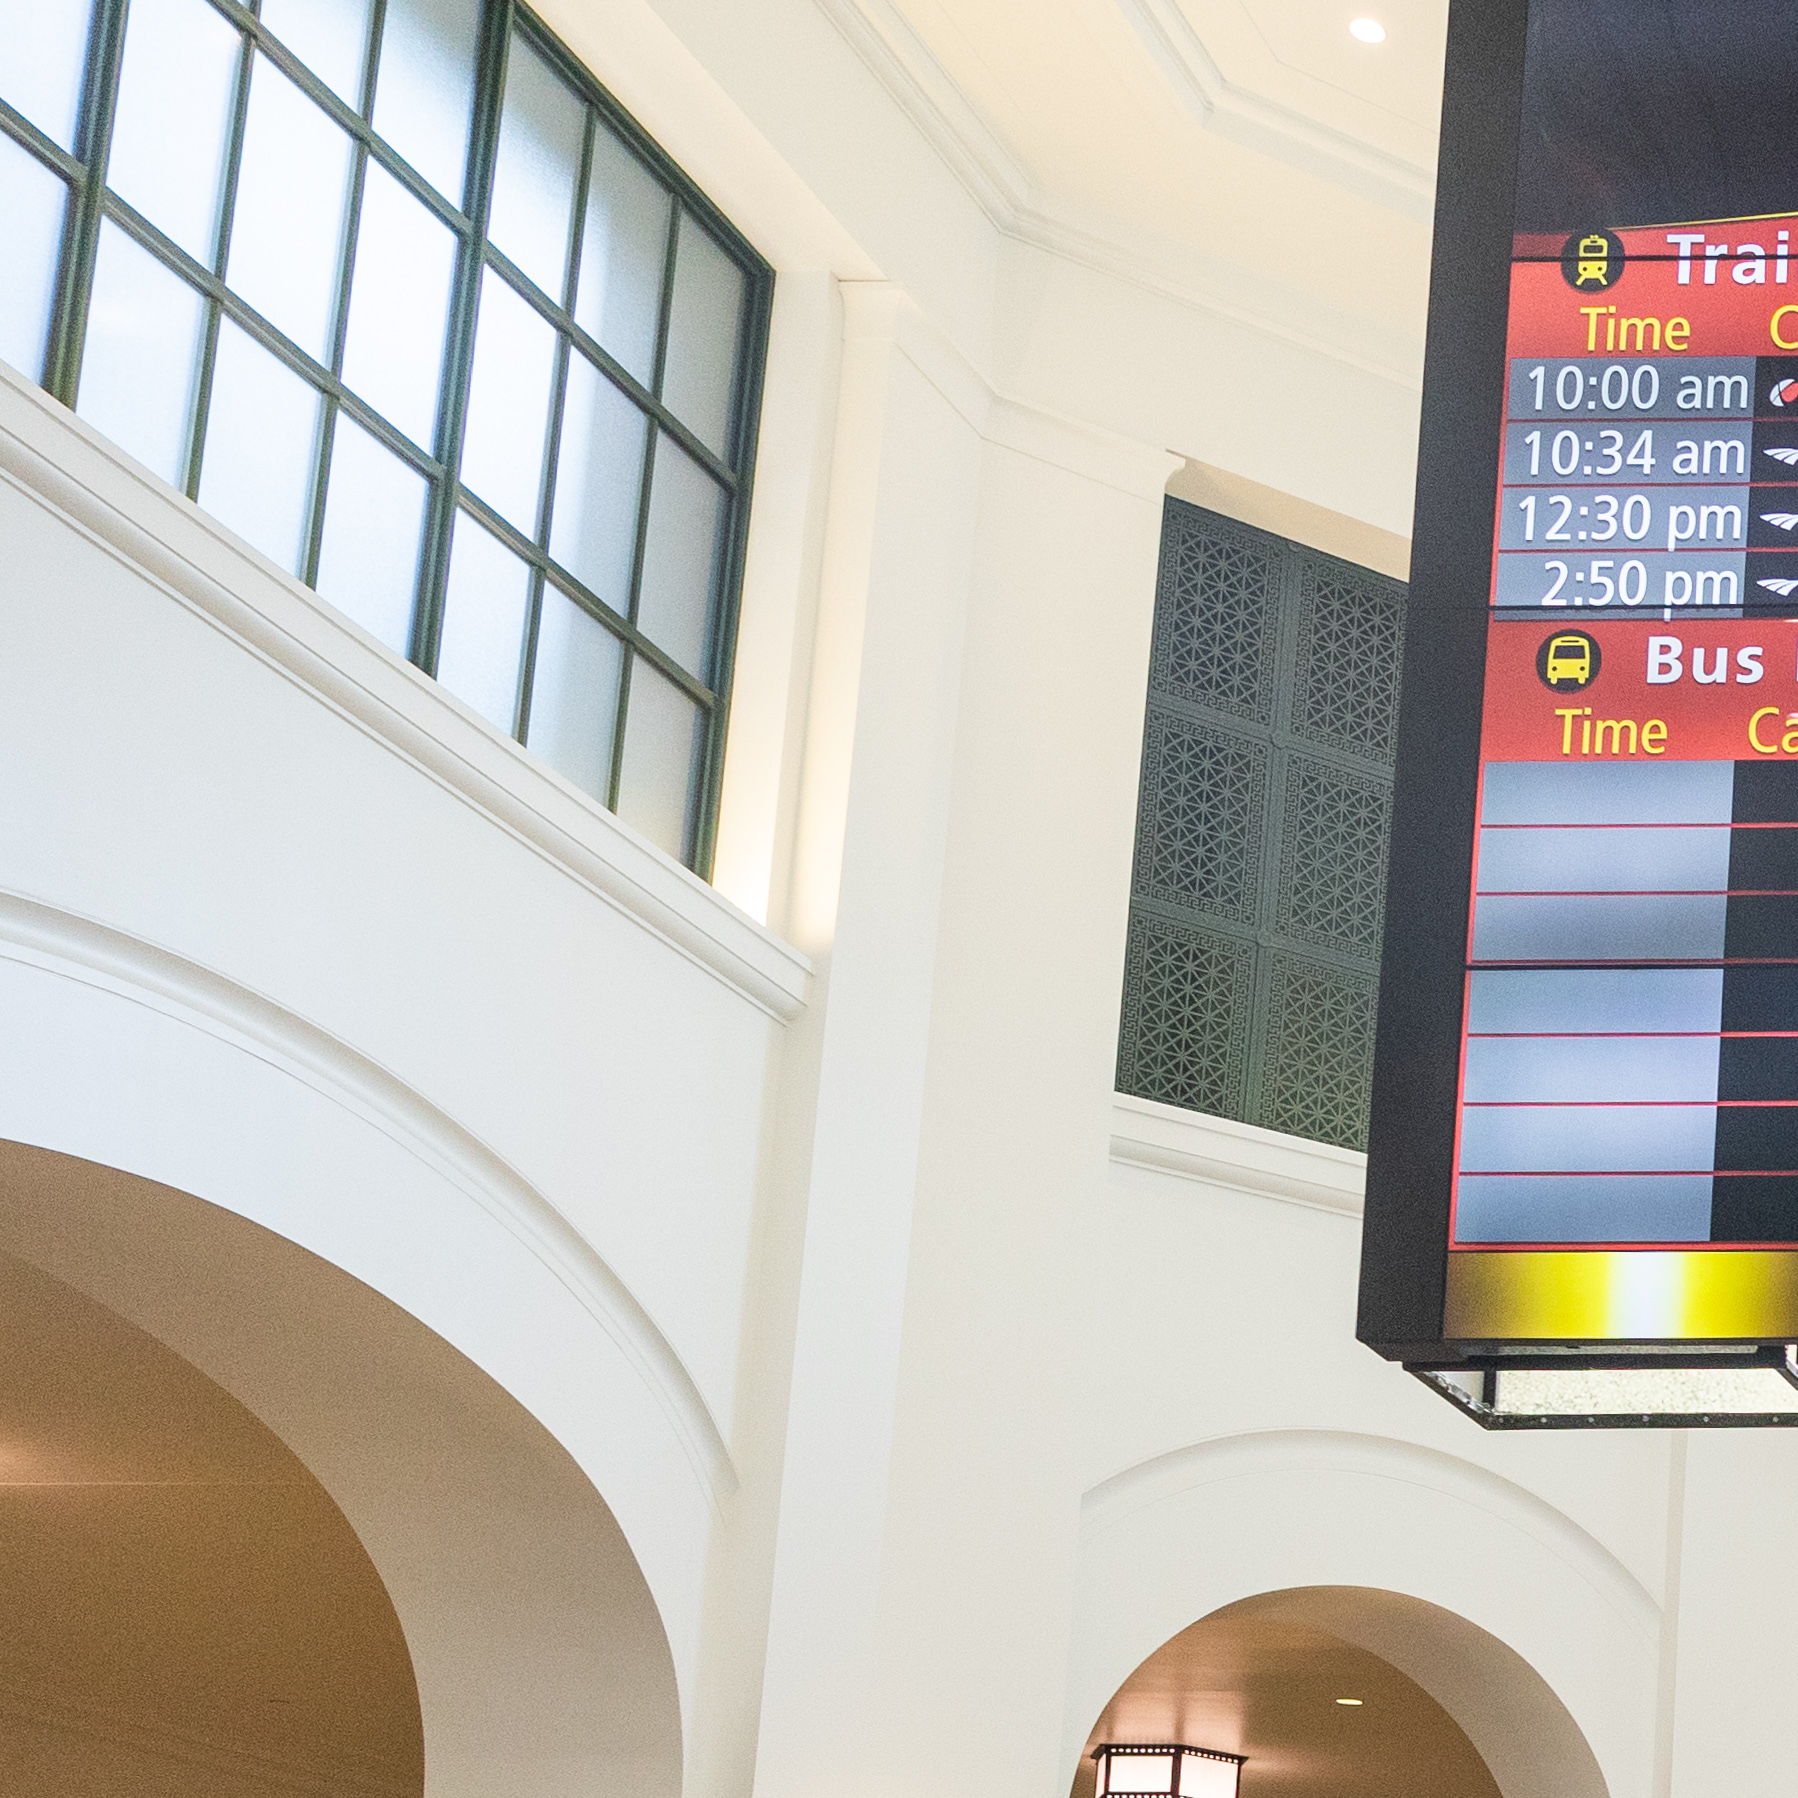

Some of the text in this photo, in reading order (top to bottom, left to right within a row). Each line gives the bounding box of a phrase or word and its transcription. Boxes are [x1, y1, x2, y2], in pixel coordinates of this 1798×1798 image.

[1579, 305, 1690, 351] Time
[1529, 365, 1659, 409] 10:00
[1677, 376, 1748, 408] am
[1525, 430, 1655, 475] 10:34
[1673, 440, 1744, 473] am
[1520, 495, 1650, 540] 12:30
[1668, 505, 1741, 551] pm
[1542, 560, 1646, 605] 2:50
[1664, 571, 1737, 621] pm
[1647, 637, 1763, 683] Bus
[1555, 707, 1667, 754] Time
